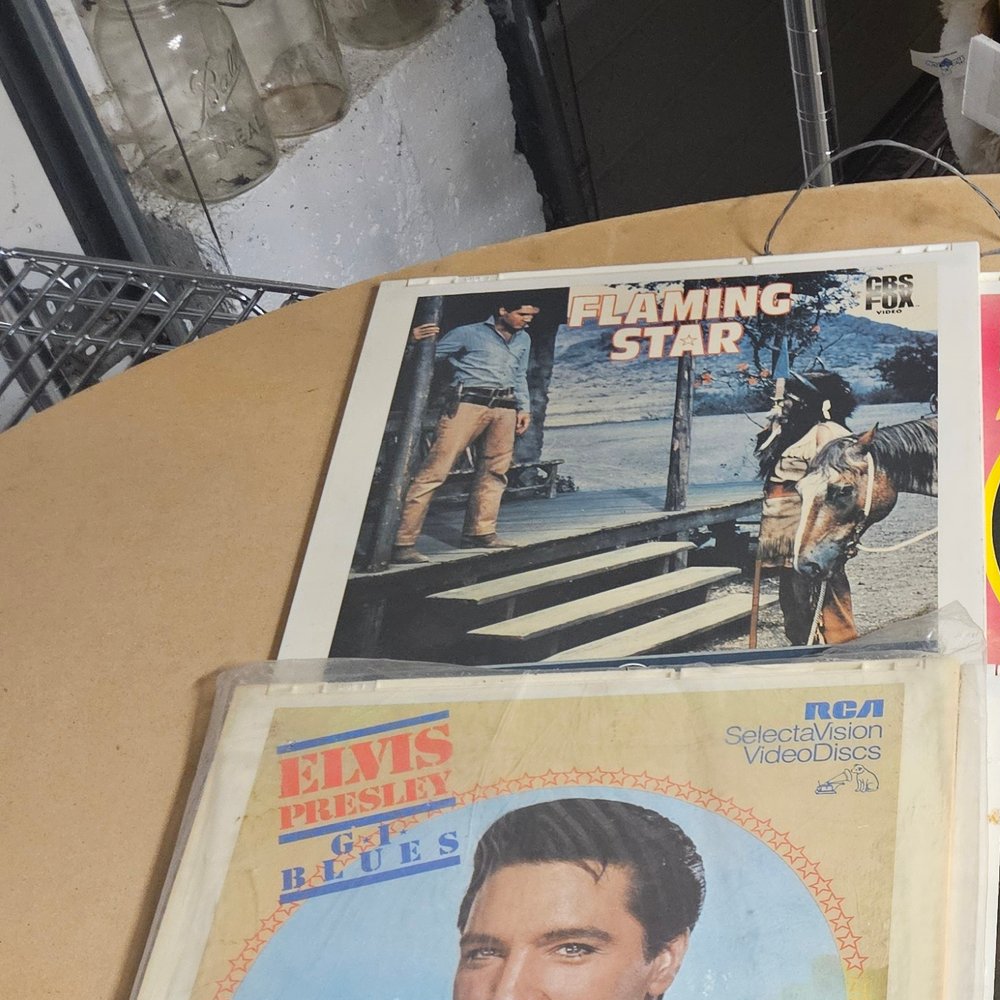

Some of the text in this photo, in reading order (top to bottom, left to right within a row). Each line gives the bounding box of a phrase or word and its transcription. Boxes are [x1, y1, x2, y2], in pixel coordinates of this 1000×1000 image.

[866, 274, 913, 292] CBS
[568, 283, 793, 329] FLAMING
[865, 289, 915, 311] FOX
[611, 322, 744, 361] STAR
[804, 699, 884, 721] RCA
[724, 722, 883, 746] SelectaVision
[278, 723, 453, 799] ELVIS
[743, 742, 882, 765] VideoDiscs
[278, 770, 452, 831] PRESLEY
